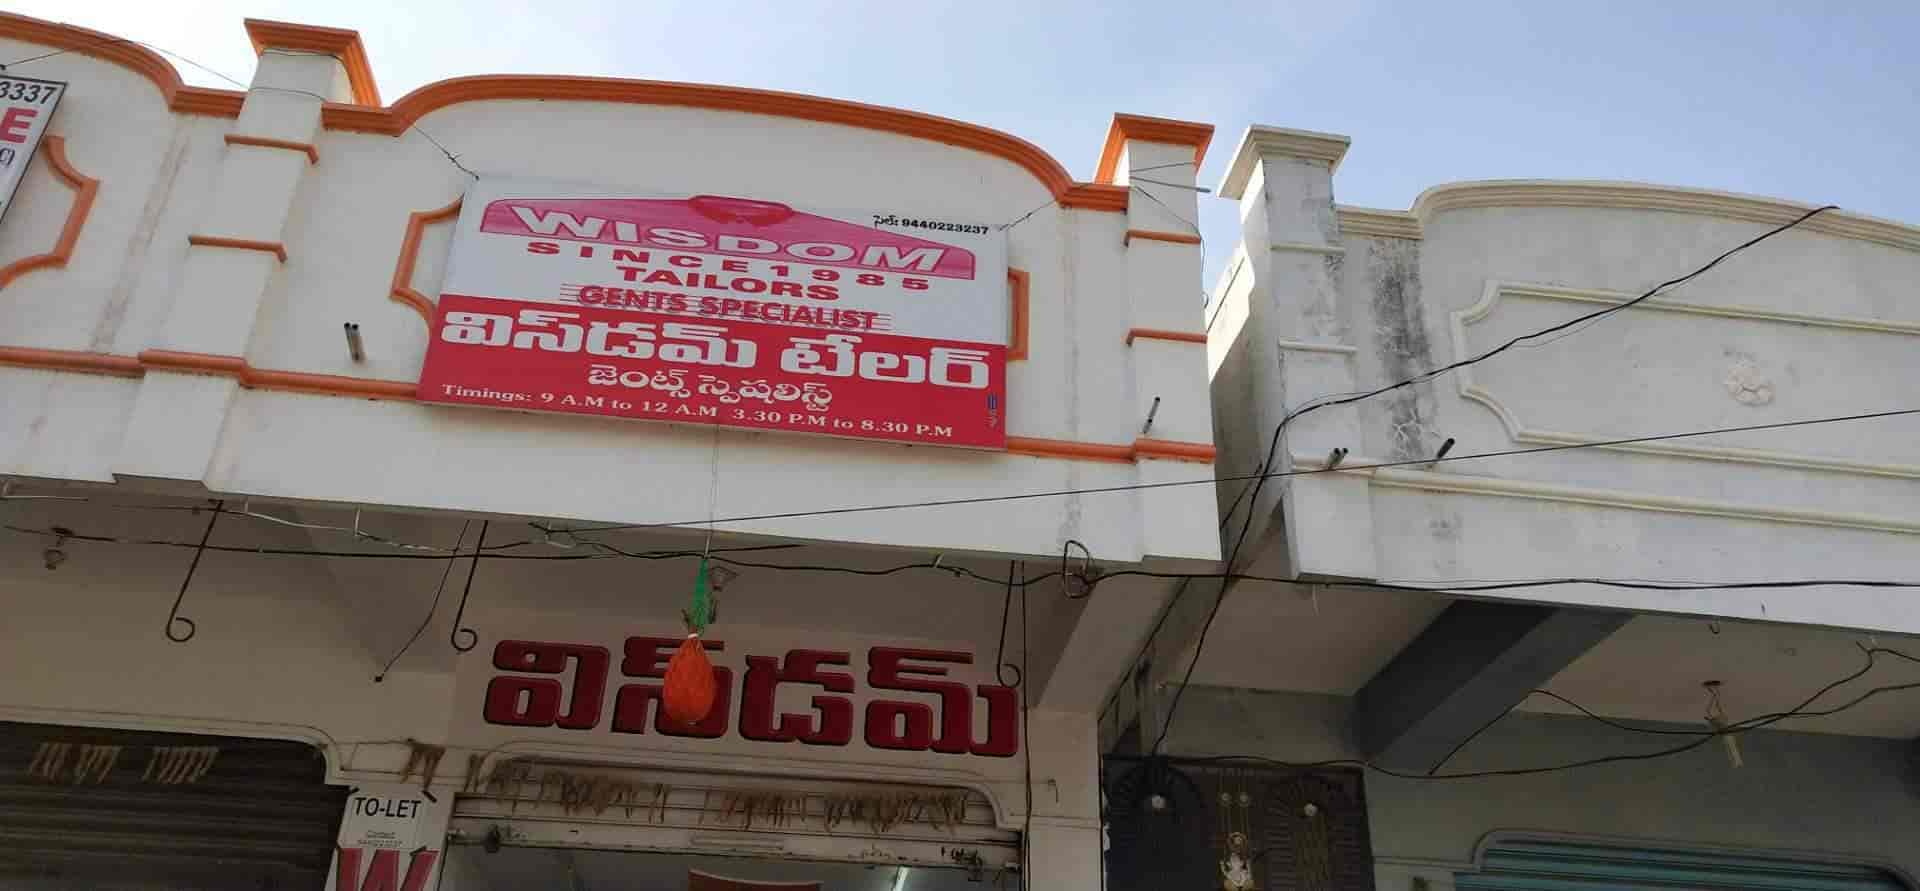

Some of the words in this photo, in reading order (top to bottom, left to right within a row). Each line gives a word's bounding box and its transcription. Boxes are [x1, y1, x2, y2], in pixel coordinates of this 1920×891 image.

[510, 204, 946, 272] WISDOM
[901, 218, 989, 235] 9440223237
[577, 283, 688, 313] GENTS
[699, 295, 879, 330] SPECIALIST
[616, 265, 840, 302] TAILORS
[780, 333, 990, 389] టేలర్
[441, 383, 532, 402] Timings:
[540, 392, 555, 403] 9
[560, 394, 604, 408] A.M
[610, 396, 633, 410] to
[641, 401, 668, 414] 12
[675, 403, 719, 417] A.M
[733, 408, 782, 423] 3.30
[788, 413, 827, 427] P.M
[833, 417, 854, 430] to
[860, 420, 909, 433] 8.30
[915, 424, 953, 438] P.M
[354, 797, 422, 819] TO-LET
